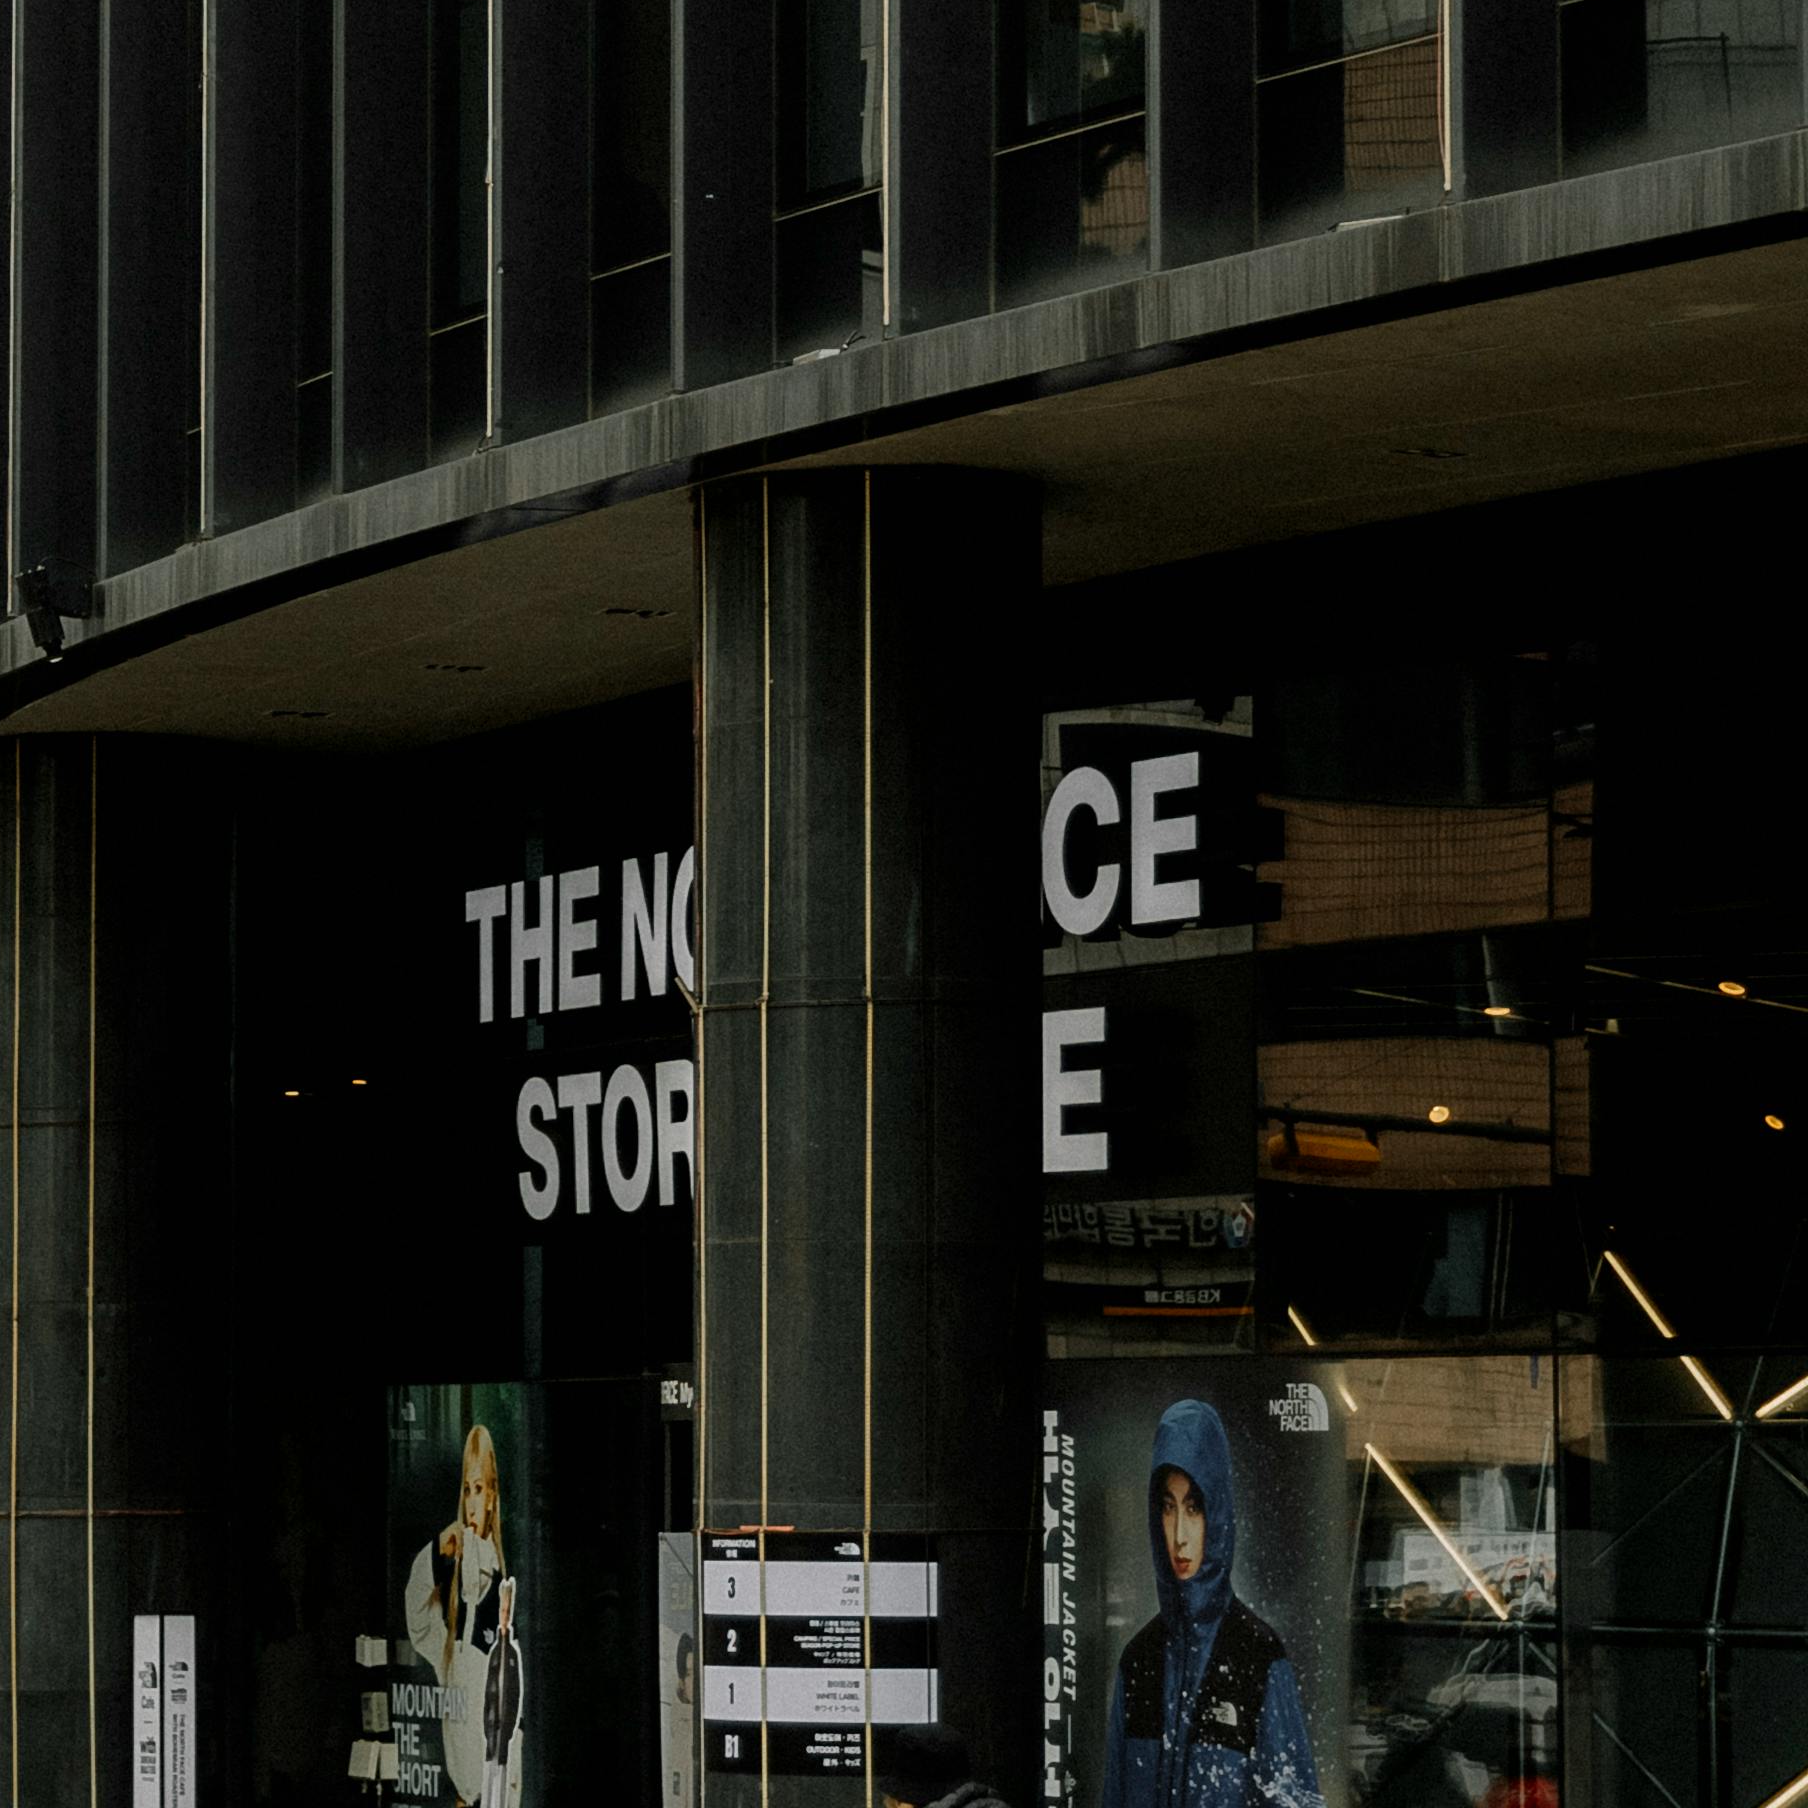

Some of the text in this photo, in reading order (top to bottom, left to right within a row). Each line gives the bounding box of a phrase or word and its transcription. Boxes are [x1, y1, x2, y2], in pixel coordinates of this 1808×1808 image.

[465, 864, 600, 1023] THE
[1285, 1382, 1309, 1399] THE
[1269, 1399, 1309, 1417] NORTH
[1280, 1415, 1310, 1432] FACE
[1061, 1432, 1078, 1702] MOUNTAIN JACKET
[727, 1576, 737, 1599] 3
[726, 1628, 738, 1653] 2
[392, 1682, 468, 1724] MOUNTAIN
[728, 1682, 735, 1705] 1
[392, 1722, 420, 1756] THE
[724, 1734, 740, 1759] B1
